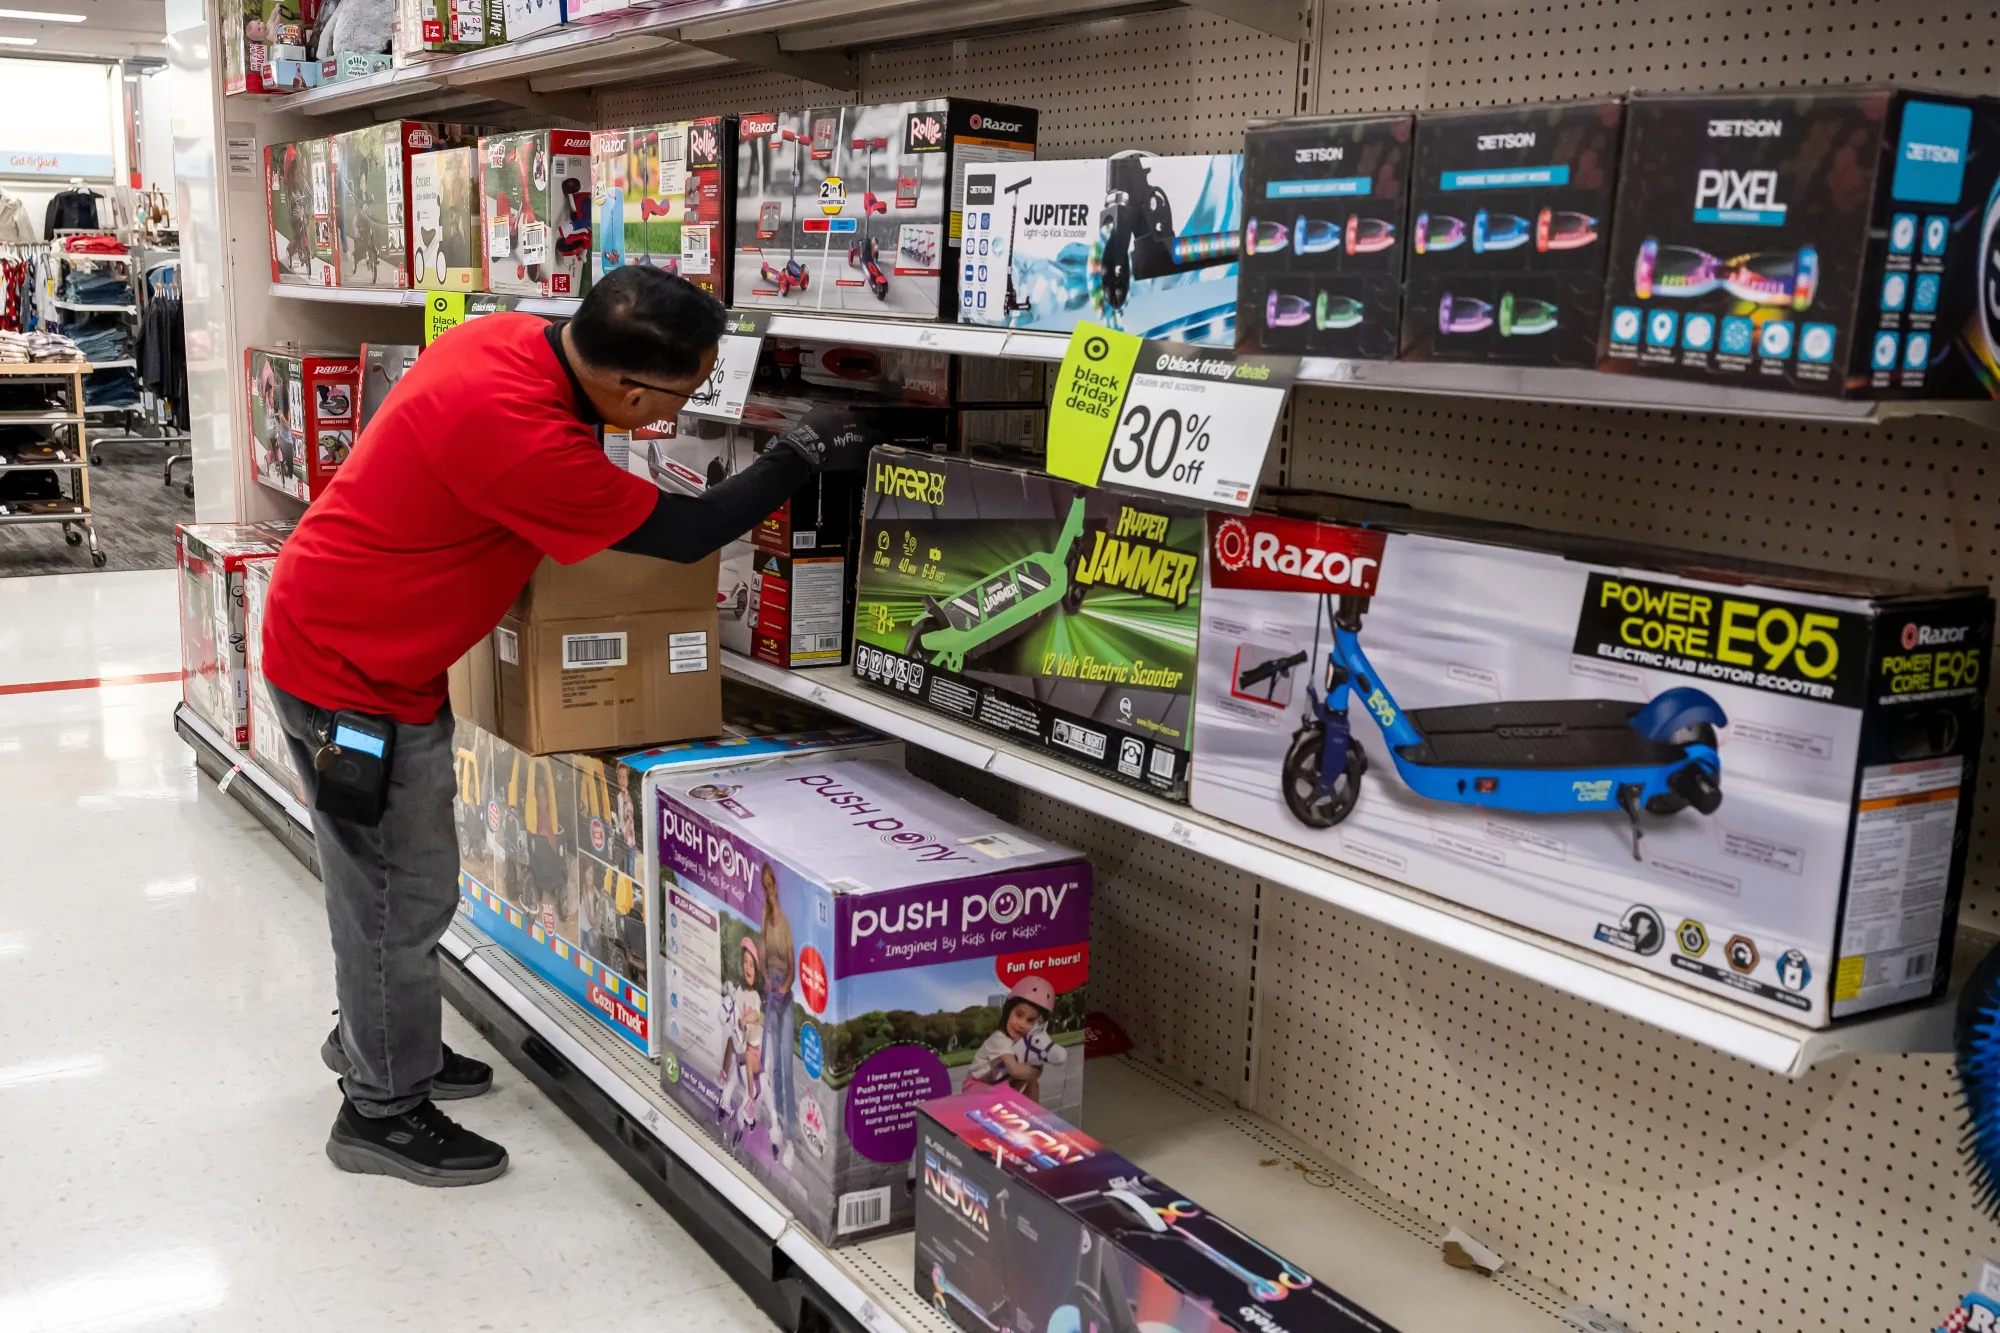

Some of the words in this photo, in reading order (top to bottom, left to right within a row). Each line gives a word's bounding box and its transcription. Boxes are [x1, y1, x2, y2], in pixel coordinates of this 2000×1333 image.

[750, 121, 776, 133] Razor
[911, 116, 942, 145] Rollie
[982, 117, 1023, 133] Razor
[1707, 119, 1783, 138] JETSON
[408, 135, 433, 146] 4-IN-1
[600, 138, 627, 153] Razor
[691, 126, 718, 163] Rollie
[1477, 132, 1536, 151] JETSON
[1295, 146, 1344, 163] JETSON
[1905, 142, 1960, 164] JETSON
[415, 175, 431, 188] Cricket
[969, 185, 993, 195] JETSON
[1695, 169, 1788, 212] PIXEL
[1024, 204, 1089, 227] JUPITER
[1024, 228, 1050, 240] Light-Up
[1050, 229, 1061, 238] Kick
[1062, 229, 1087, 238] Scooter
[432, 316, 458, 326] black
[1074, 365, 1119, 391] black
[1169, 356, 1199, 374] black
[1199, 359, 1237, 380] friday
[1235, 364, 1271, 380] deals
[1071, 380, 1119, 408] friday
[1135, 376, 1158, 388] Skates
[1159, 379, 1173, 390] and
[1174, 380, 1206, 394] scooters
[1065, 395, 1110, 419] deals
[833, 432, 863, 448] HyFlex
[1113, 405, 1182, 480] 30
[1185, 414, 1212, 452] %
[672, 466, 694, 480] Razor
[1172, 459, 1205, 485] off
[1116, 506, 1168, 544] HYPER
[872, 551, 882, 565] 10
[898, 558, 908, 573] 40
[1075, 531, 1198, 606] JAMMER
[1252, 532, 1378, 588] Razor
[921, 564, 935, 580] 6-8
[983, 583, 1020, 613] JAMMER
[1601, 580, 1713, 626] POWER
[1716, 600, 1840, 680] E95
[1620, 617, 1710, 659] CORE
[1918, 625, 1970, 646] Razor
[1041, 653, 1056, 676] 12
[1056, 654, 1080, 678] Volt
[1079, 655, 1129, 683] Electric
[1130, 660, 1184, 689] Scooter
[1597, 643, 1663, 667] ELECTRIC
[1664, 656, 1697, 673] HUB
[1698, 662, 1754, 685] MOTOR
[1755, 672, 1835, 700] SCOOTER
[1881, 653, 1933, 676] POWER
[1934, 649, 1980, 689] E95
[1891, 672, 1931, 694] CORE
[673, 849, 698, 875] Imagined
[885, 939, 937, 961] Imagined
[942, 937, 957, 953] By
[961, 933, 985, 946] Kids
[990, 928, 1007, 943] for
[1012, 925, 1037, 938] Kids!
[1007, 961, 1026, 974] Fun
[1028, 959, 1045, 971] for
[1048, 952, 1081, 967] hours!
[592, 985, 615, 1020] Cozy
[616, 1001, 645, 1035] Truck
[856, 1084, 877, 1095] Push
[901, 1078, 914, 1087] it's
[915, 1076, 930, 1085] like
[871, 1072, 888, 1082] love
[889, 1071, 902, 1080] my
[903, 1067, 920, 1076] new
[854, 1095, 881, 1106] having
[881, 1093, 894, 1101] my
[896, 1089, 914, 1098] very
[915, 1086, 932, 1096] own
[860, 1105, 877, 1116] real
[878, 1102, 903, 1112] horse,
[864, 1116, 882, 1126] sure
[884, 1114, 899, 1124] you
[900, 1110, 917, 1119] nam
[874, 1125, 896, 1136] yours
[897, 1120, 914, 1131] too!
[924, 1166, 990, 1233] NOVA
